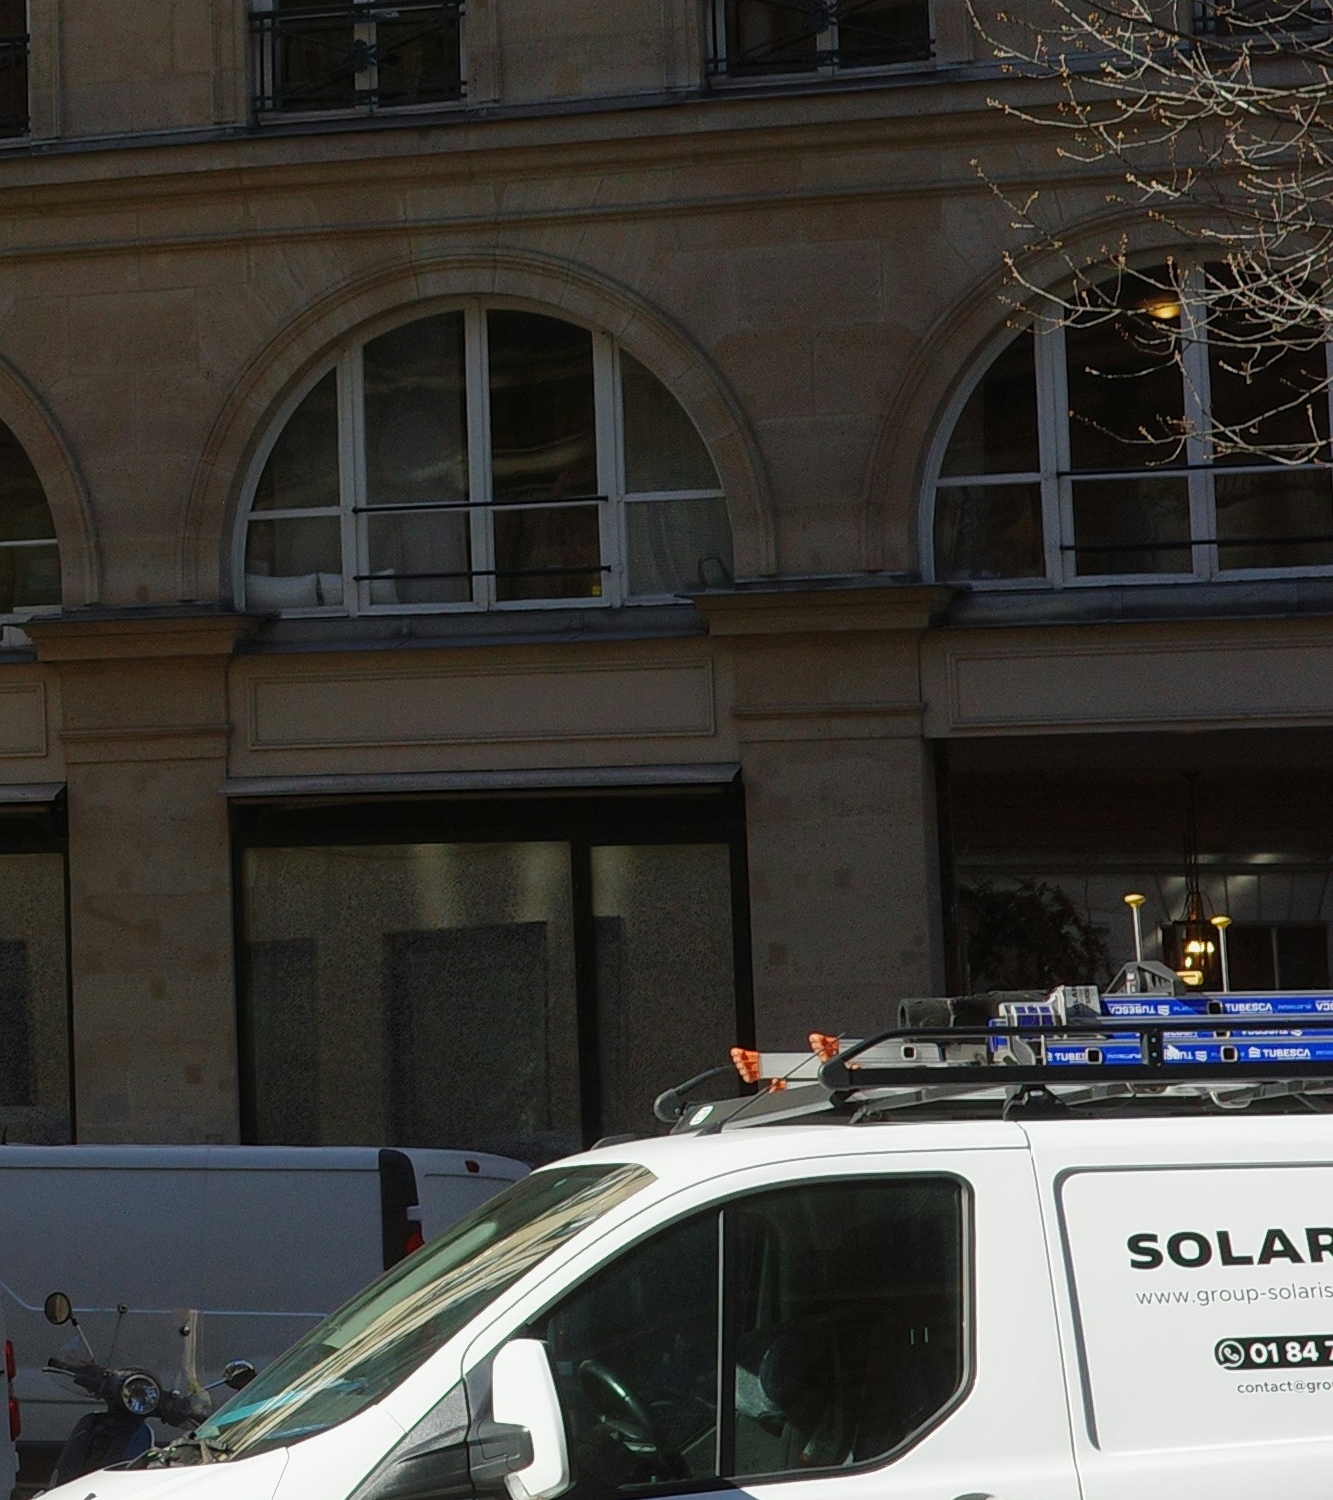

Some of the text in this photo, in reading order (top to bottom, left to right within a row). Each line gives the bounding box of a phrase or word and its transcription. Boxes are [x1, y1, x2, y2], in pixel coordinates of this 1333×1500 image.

[1224, 1002, 1273, 1012] TUBESCA
[1262, 1047, 1311, 1058] TUBESCA
[1249, 1342, 1279, 1364] 01
[1285, 1340, 1319, 1363] 84
[1237, 1379, 1333, 1395] contact@gro
